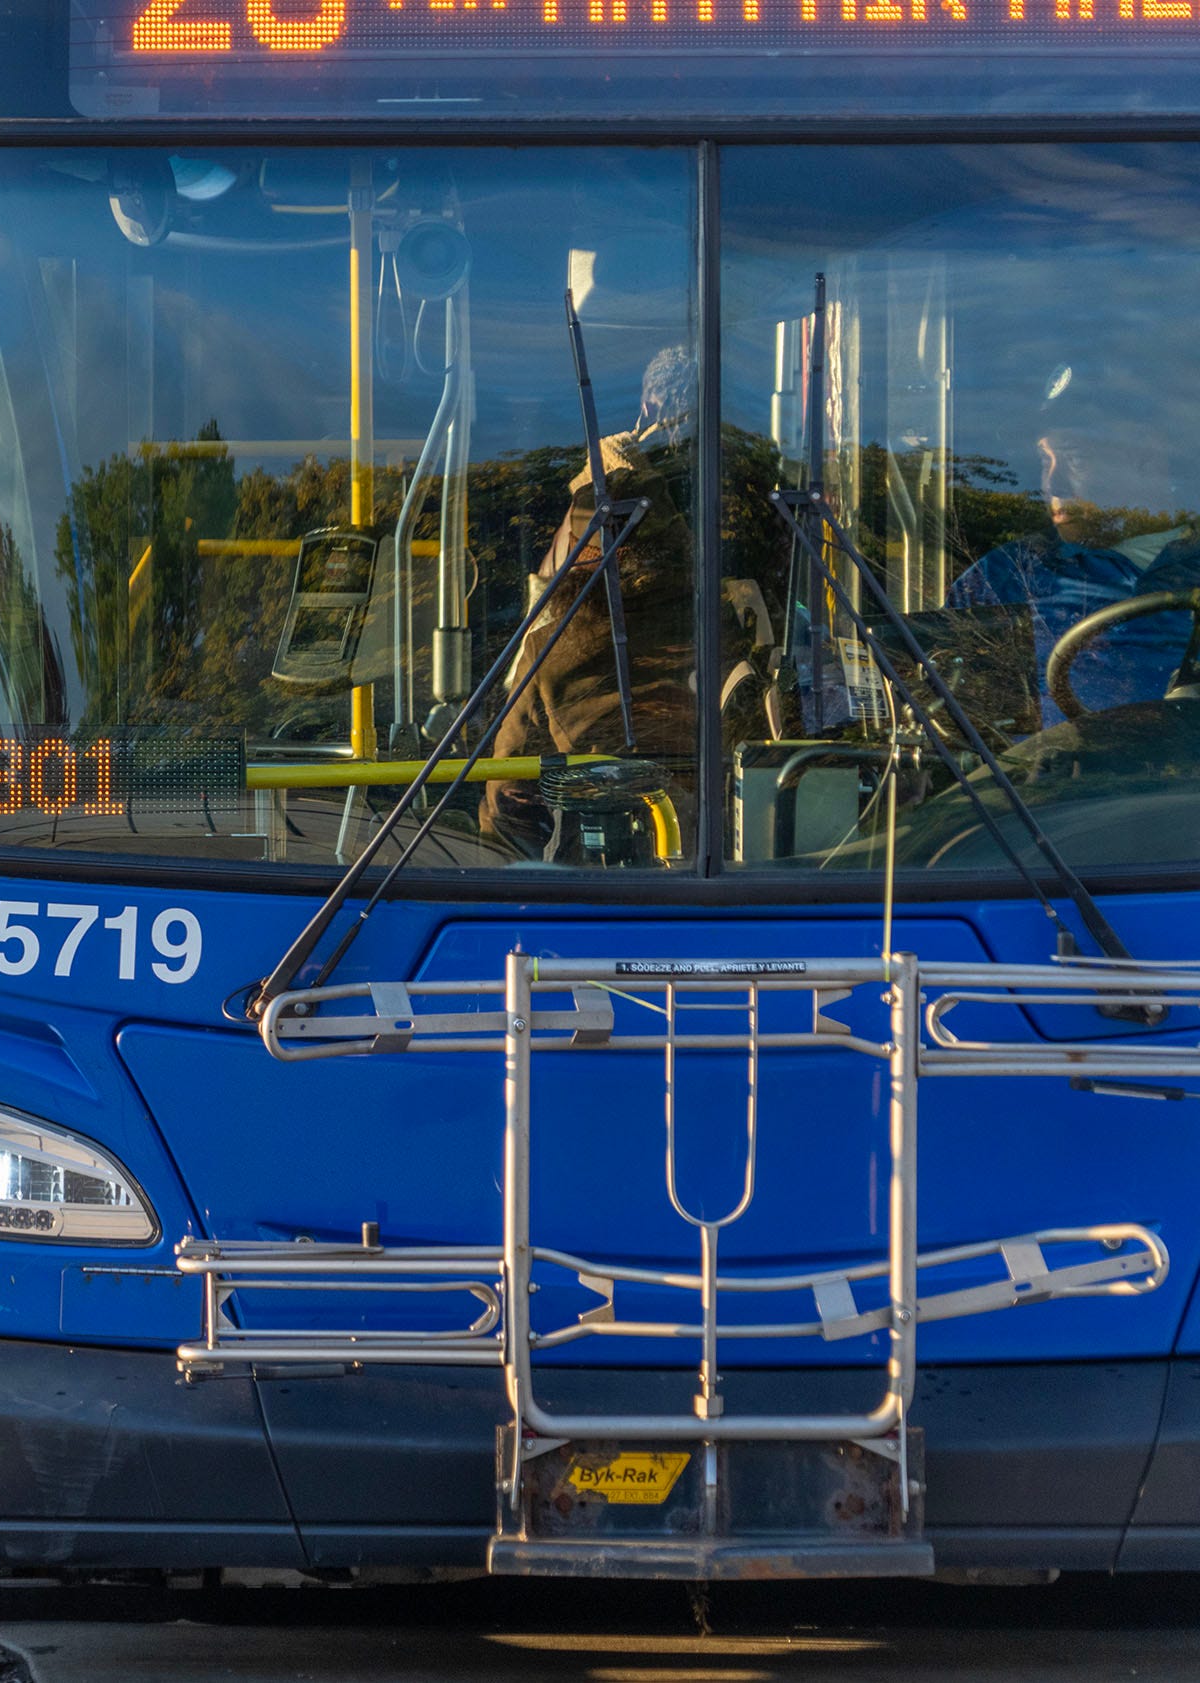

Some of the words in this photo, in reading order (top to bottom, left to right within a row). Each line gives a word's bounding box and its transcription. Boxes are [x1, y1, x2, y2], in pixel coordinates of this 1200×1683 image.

[631, 963, 672, 972] SQUEEZE
[673, 963, 693, 972] AND
[720, 963, 757, 972] APRIETE
[758, 963, 766, 971] Y
[767, 962, 806, 971] LEVANTE
[579, 1467, 658, 1486] Byk-Rak
